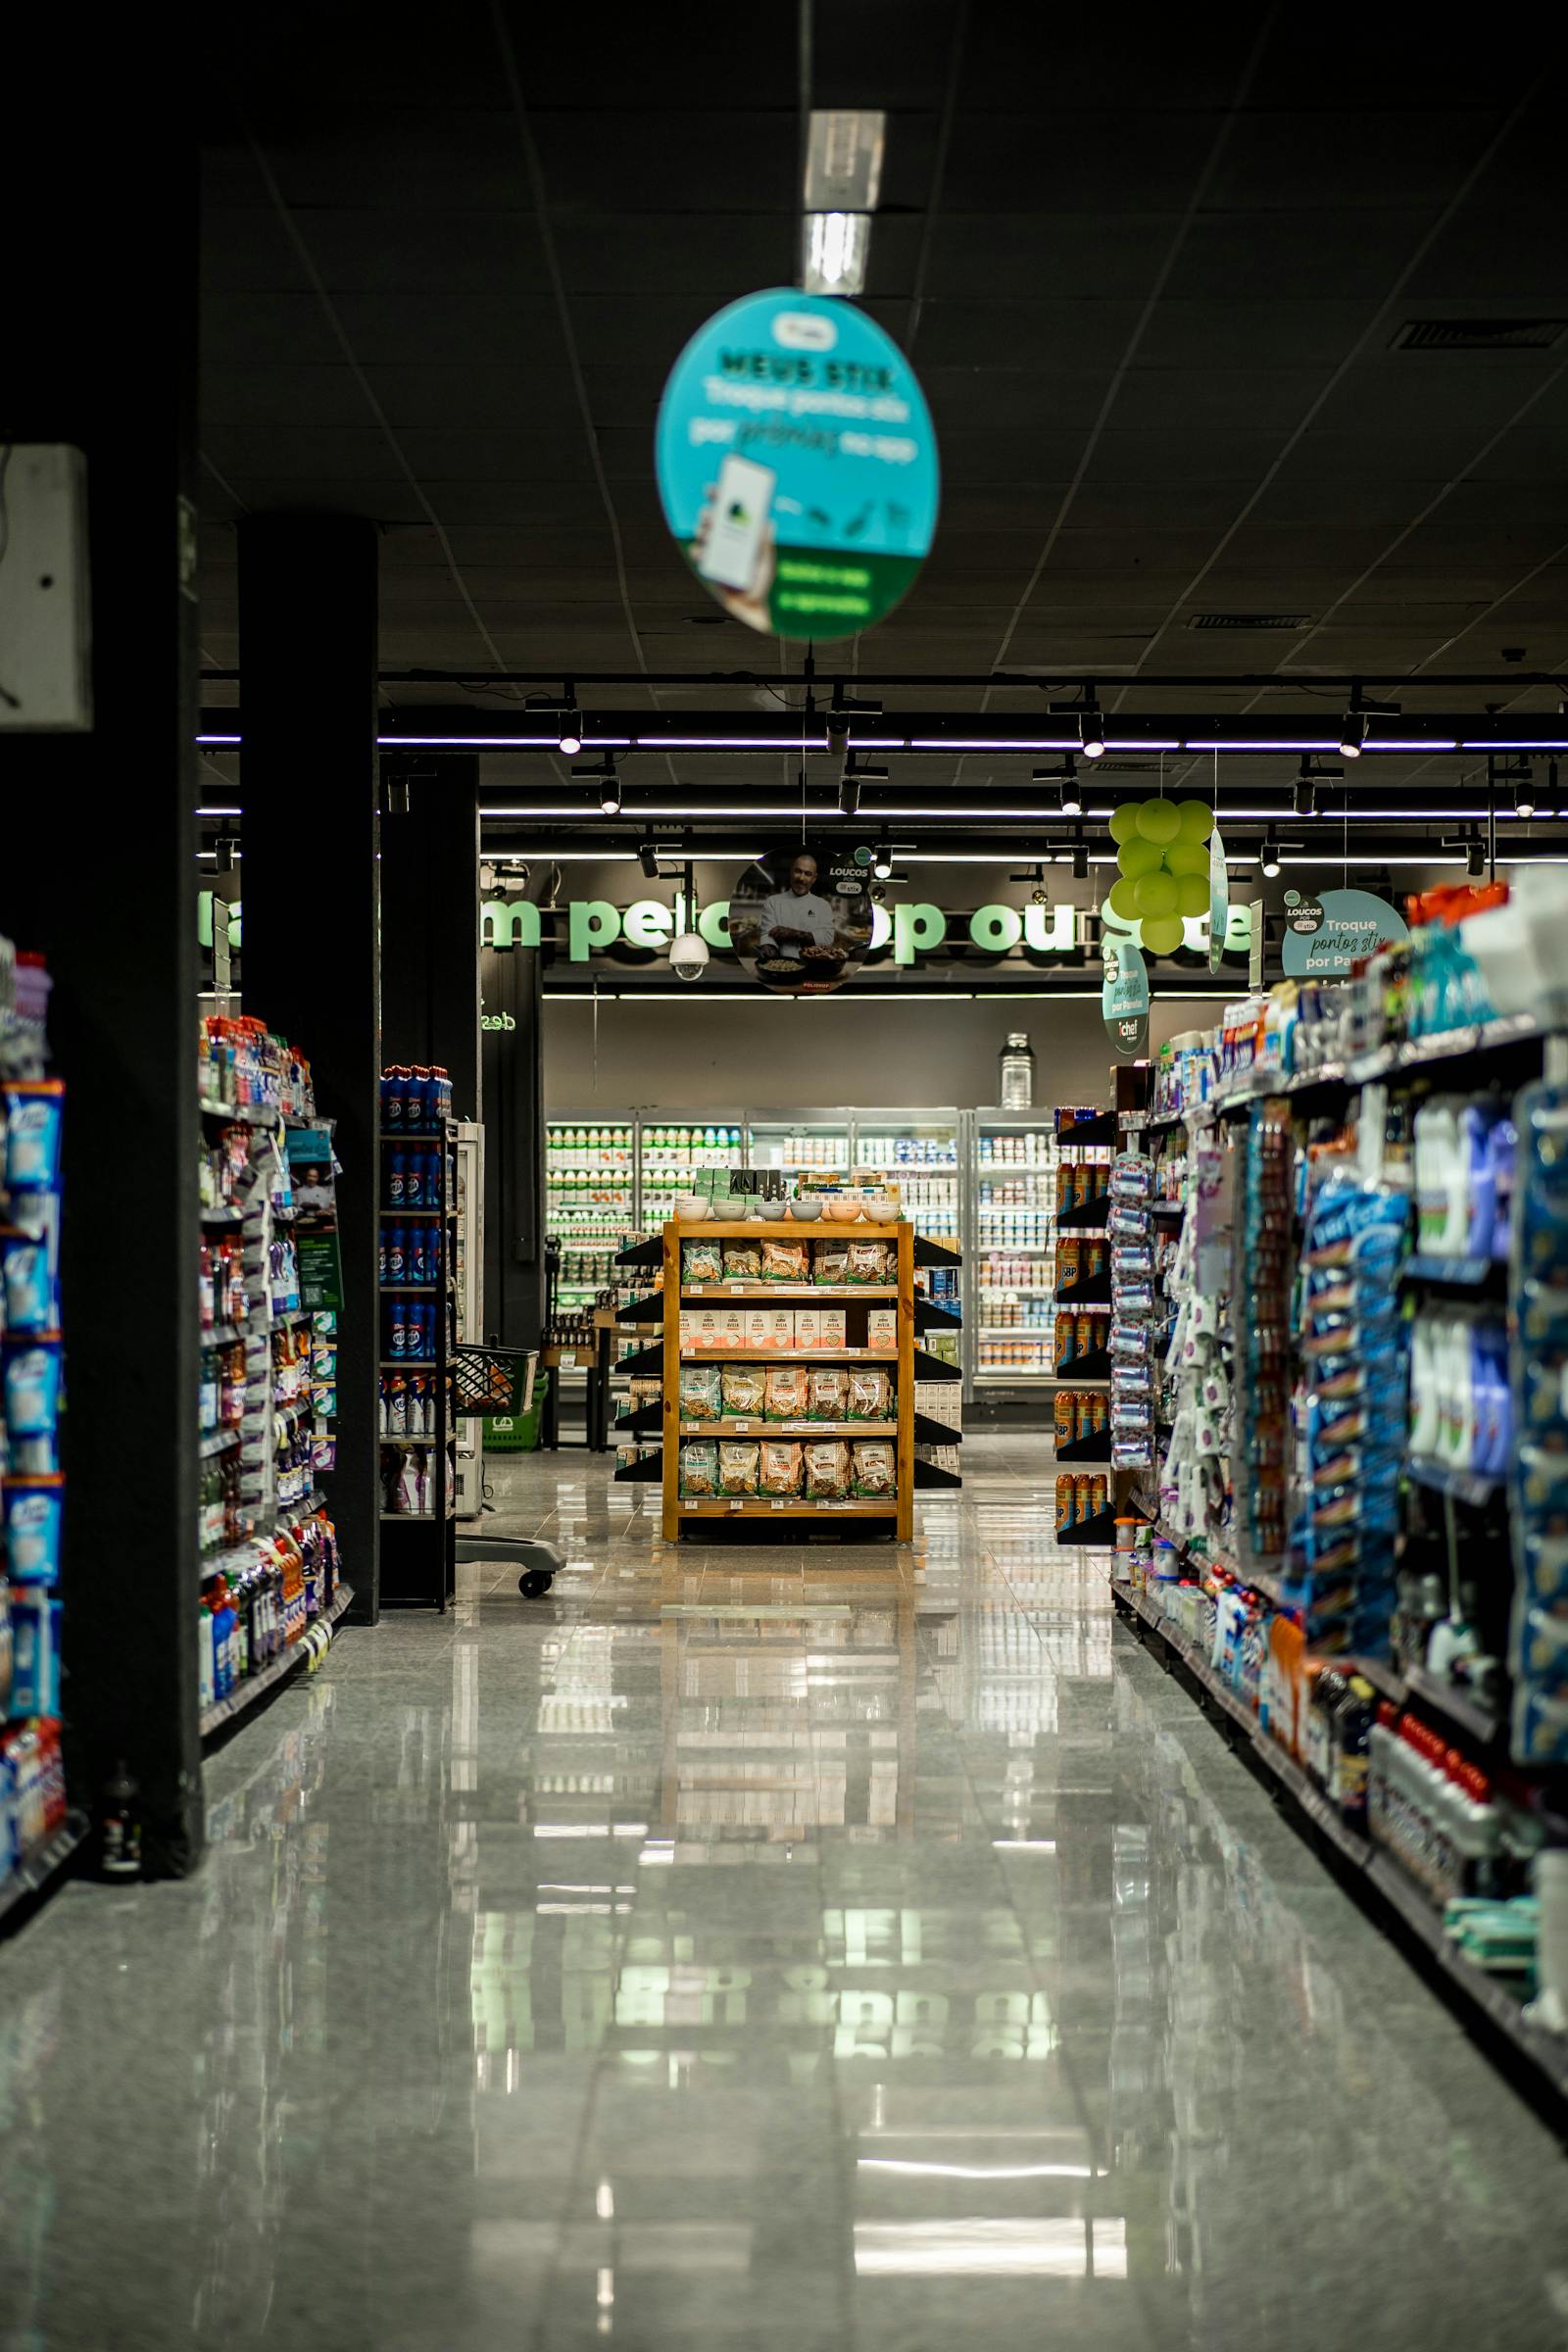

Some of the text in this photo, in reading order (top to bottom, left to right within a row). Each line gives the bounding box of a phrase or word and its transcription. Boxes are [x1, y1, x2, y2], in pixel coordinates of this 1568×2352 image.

[829, 867, 868, 878] LOUCOS
[1287, 907, 1322, 916] LOUCOS
[969, 903, 1076, 952] ou
[1326, 919, 1377, 933] Troque
[1309, 931, 1358, 957] pontos
[1306, 958, 1330, 970] por
[1118, 1019, 1138, 1036] ichef
